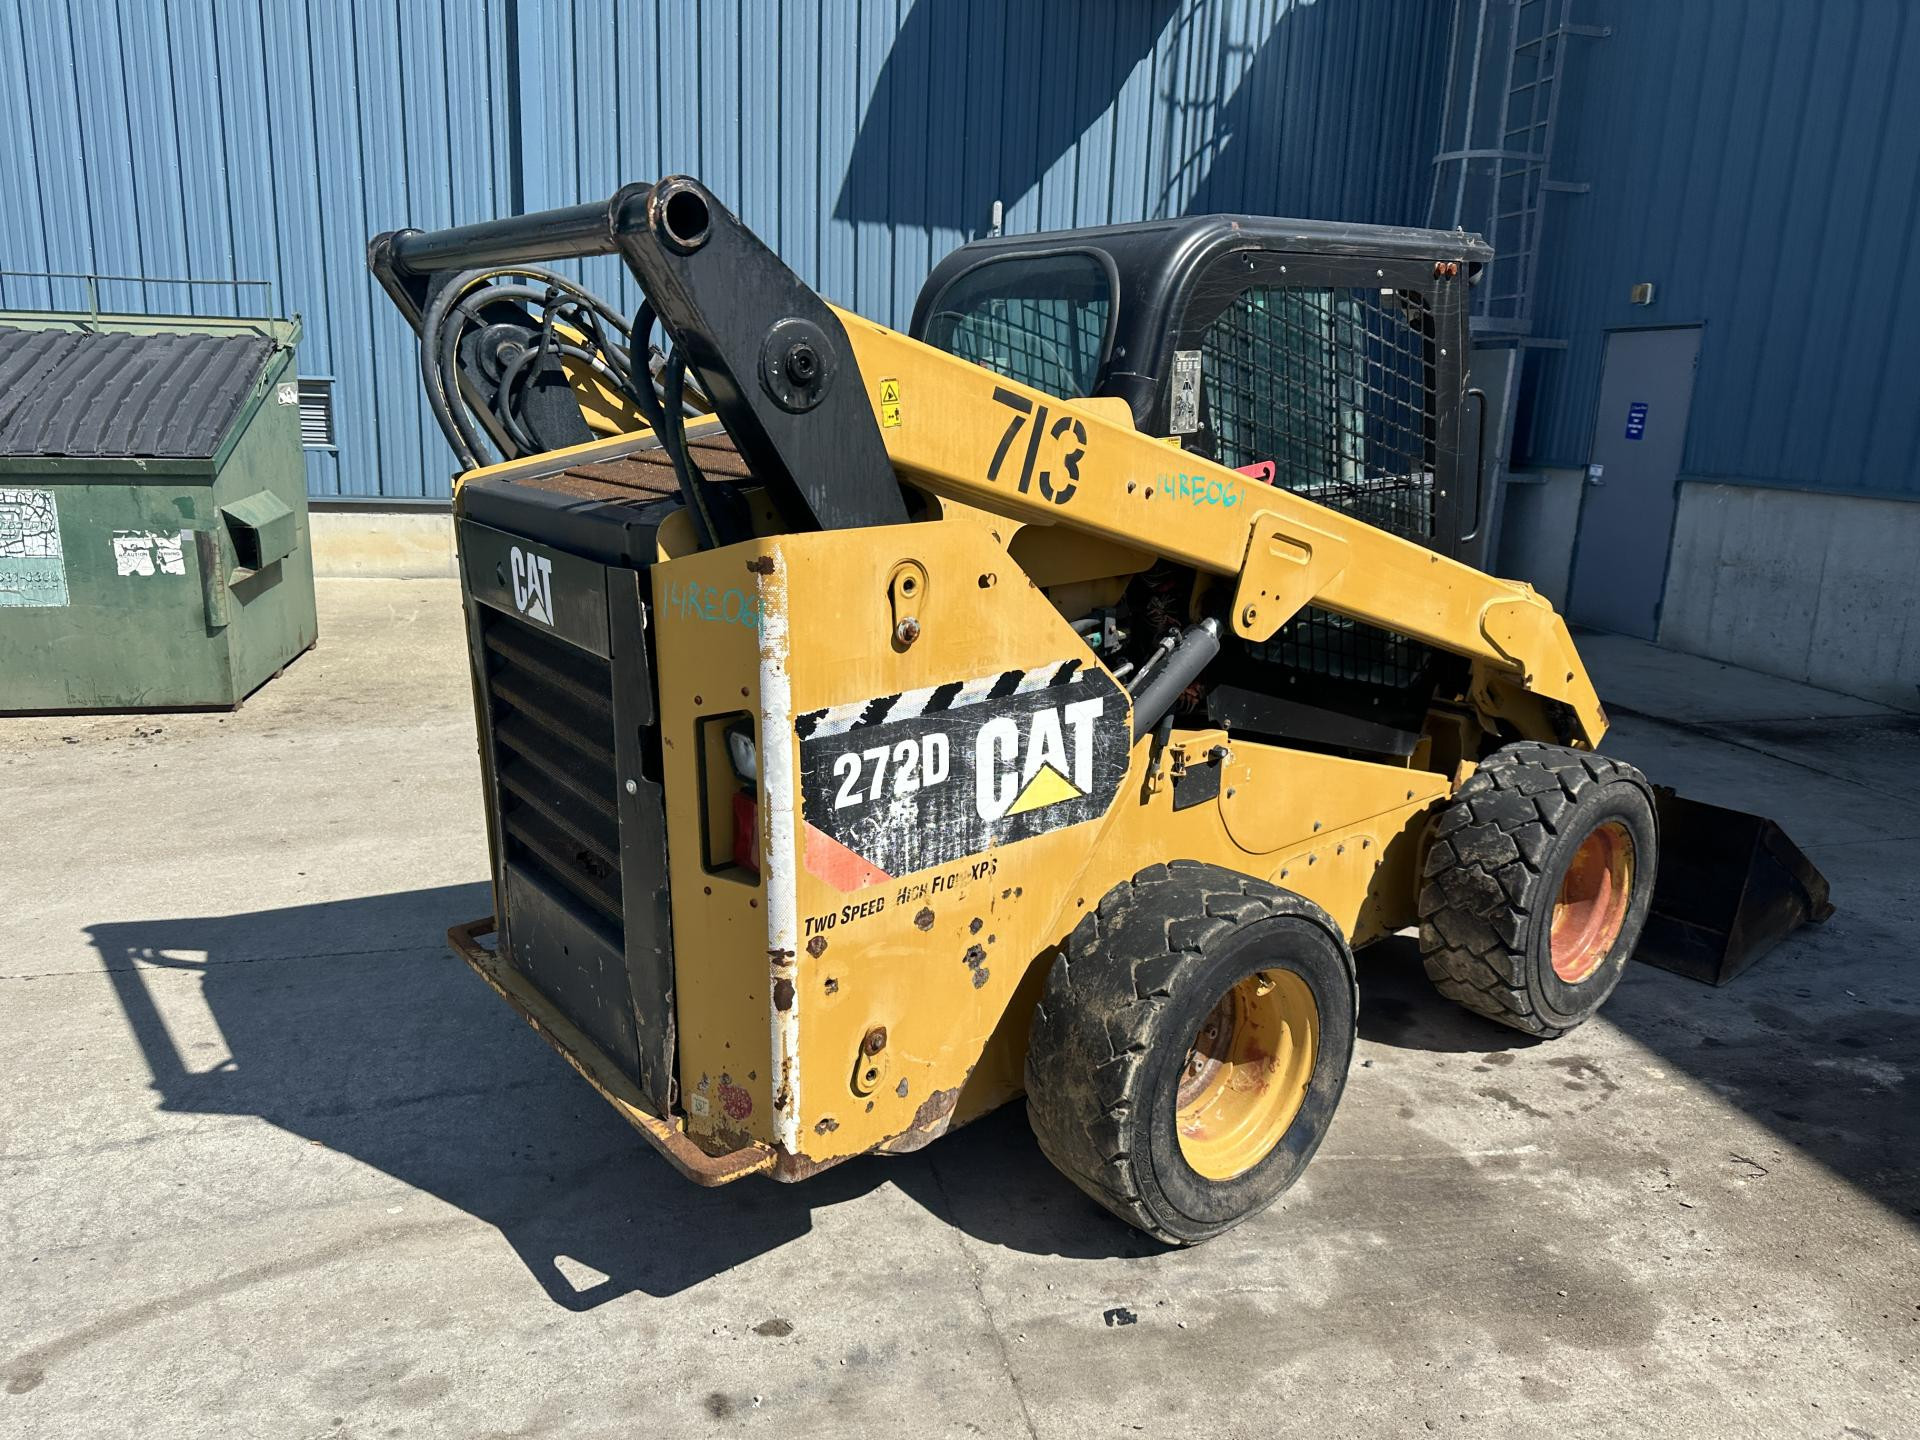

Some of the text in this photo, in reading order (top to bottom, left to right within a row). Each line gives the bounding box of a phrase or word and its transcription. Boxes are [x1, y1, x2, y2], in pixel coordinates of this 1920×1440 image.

[987, 386, 1087, 505] 713
[1156, 472, 1246, 507] 14RE061
[510, 546, 554, 627] CAT
[833, 697, 1103, 822] 272D CAT
